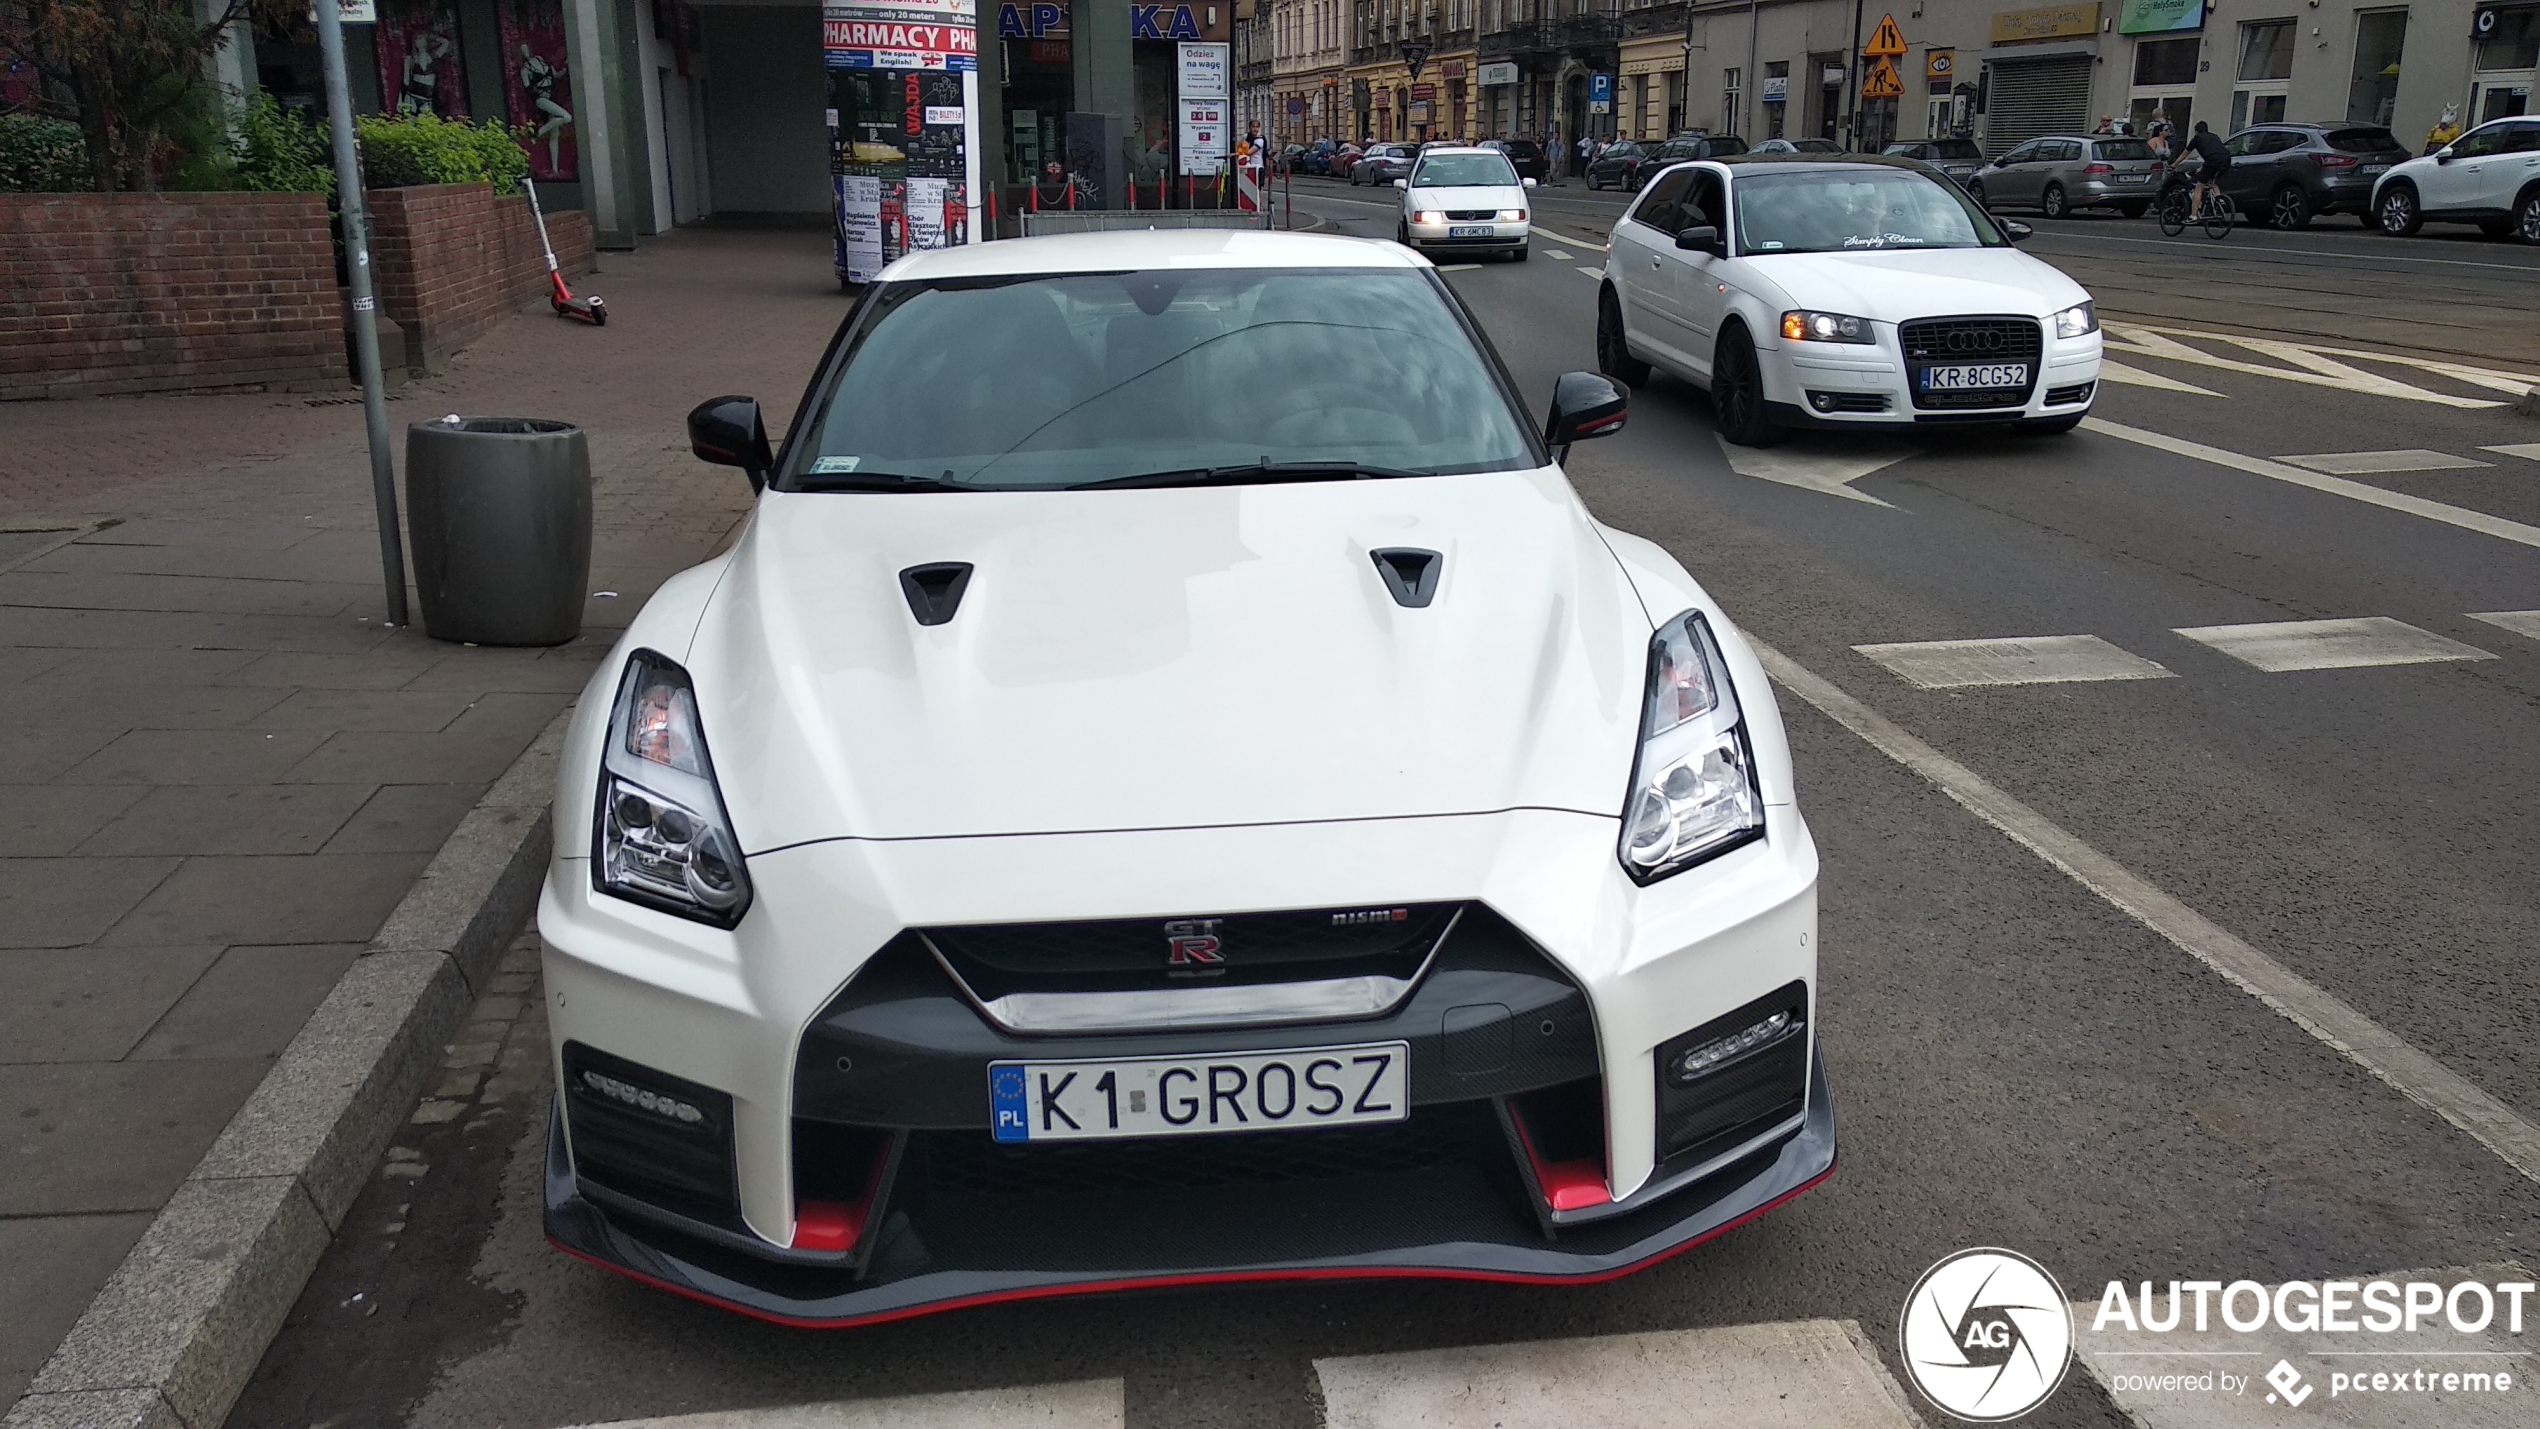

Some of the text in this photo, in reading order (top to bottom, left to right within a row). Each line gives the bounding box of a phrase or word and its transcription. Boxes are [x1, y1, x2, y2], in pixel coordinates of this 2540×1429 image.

[879, 10, 896, 19] only
[824, 22, 940, 48] PHARMACY
[880, 58, 912, 66] English!
[1199, 61, 1221, 70] wagę
[2200, 60, 2210, 72] 29
[1595, 75, 1607, 94] P
[905, 72, 922, 136] WAJDA
[908, 214, 925, 222] Chór
[1843, 233, 1924, 248] Simply Clean
[1933, 366, 2024, 387] KR 8CG52
[1924, 393, 2017, 405] quattro
[1164, 918, 1223, 935] GT
[1168, 935, 1227, 964] R
[1039, 1053, 1393, 1131] K1 GROSZ
[999, 1110, 1024, 1128] PL
